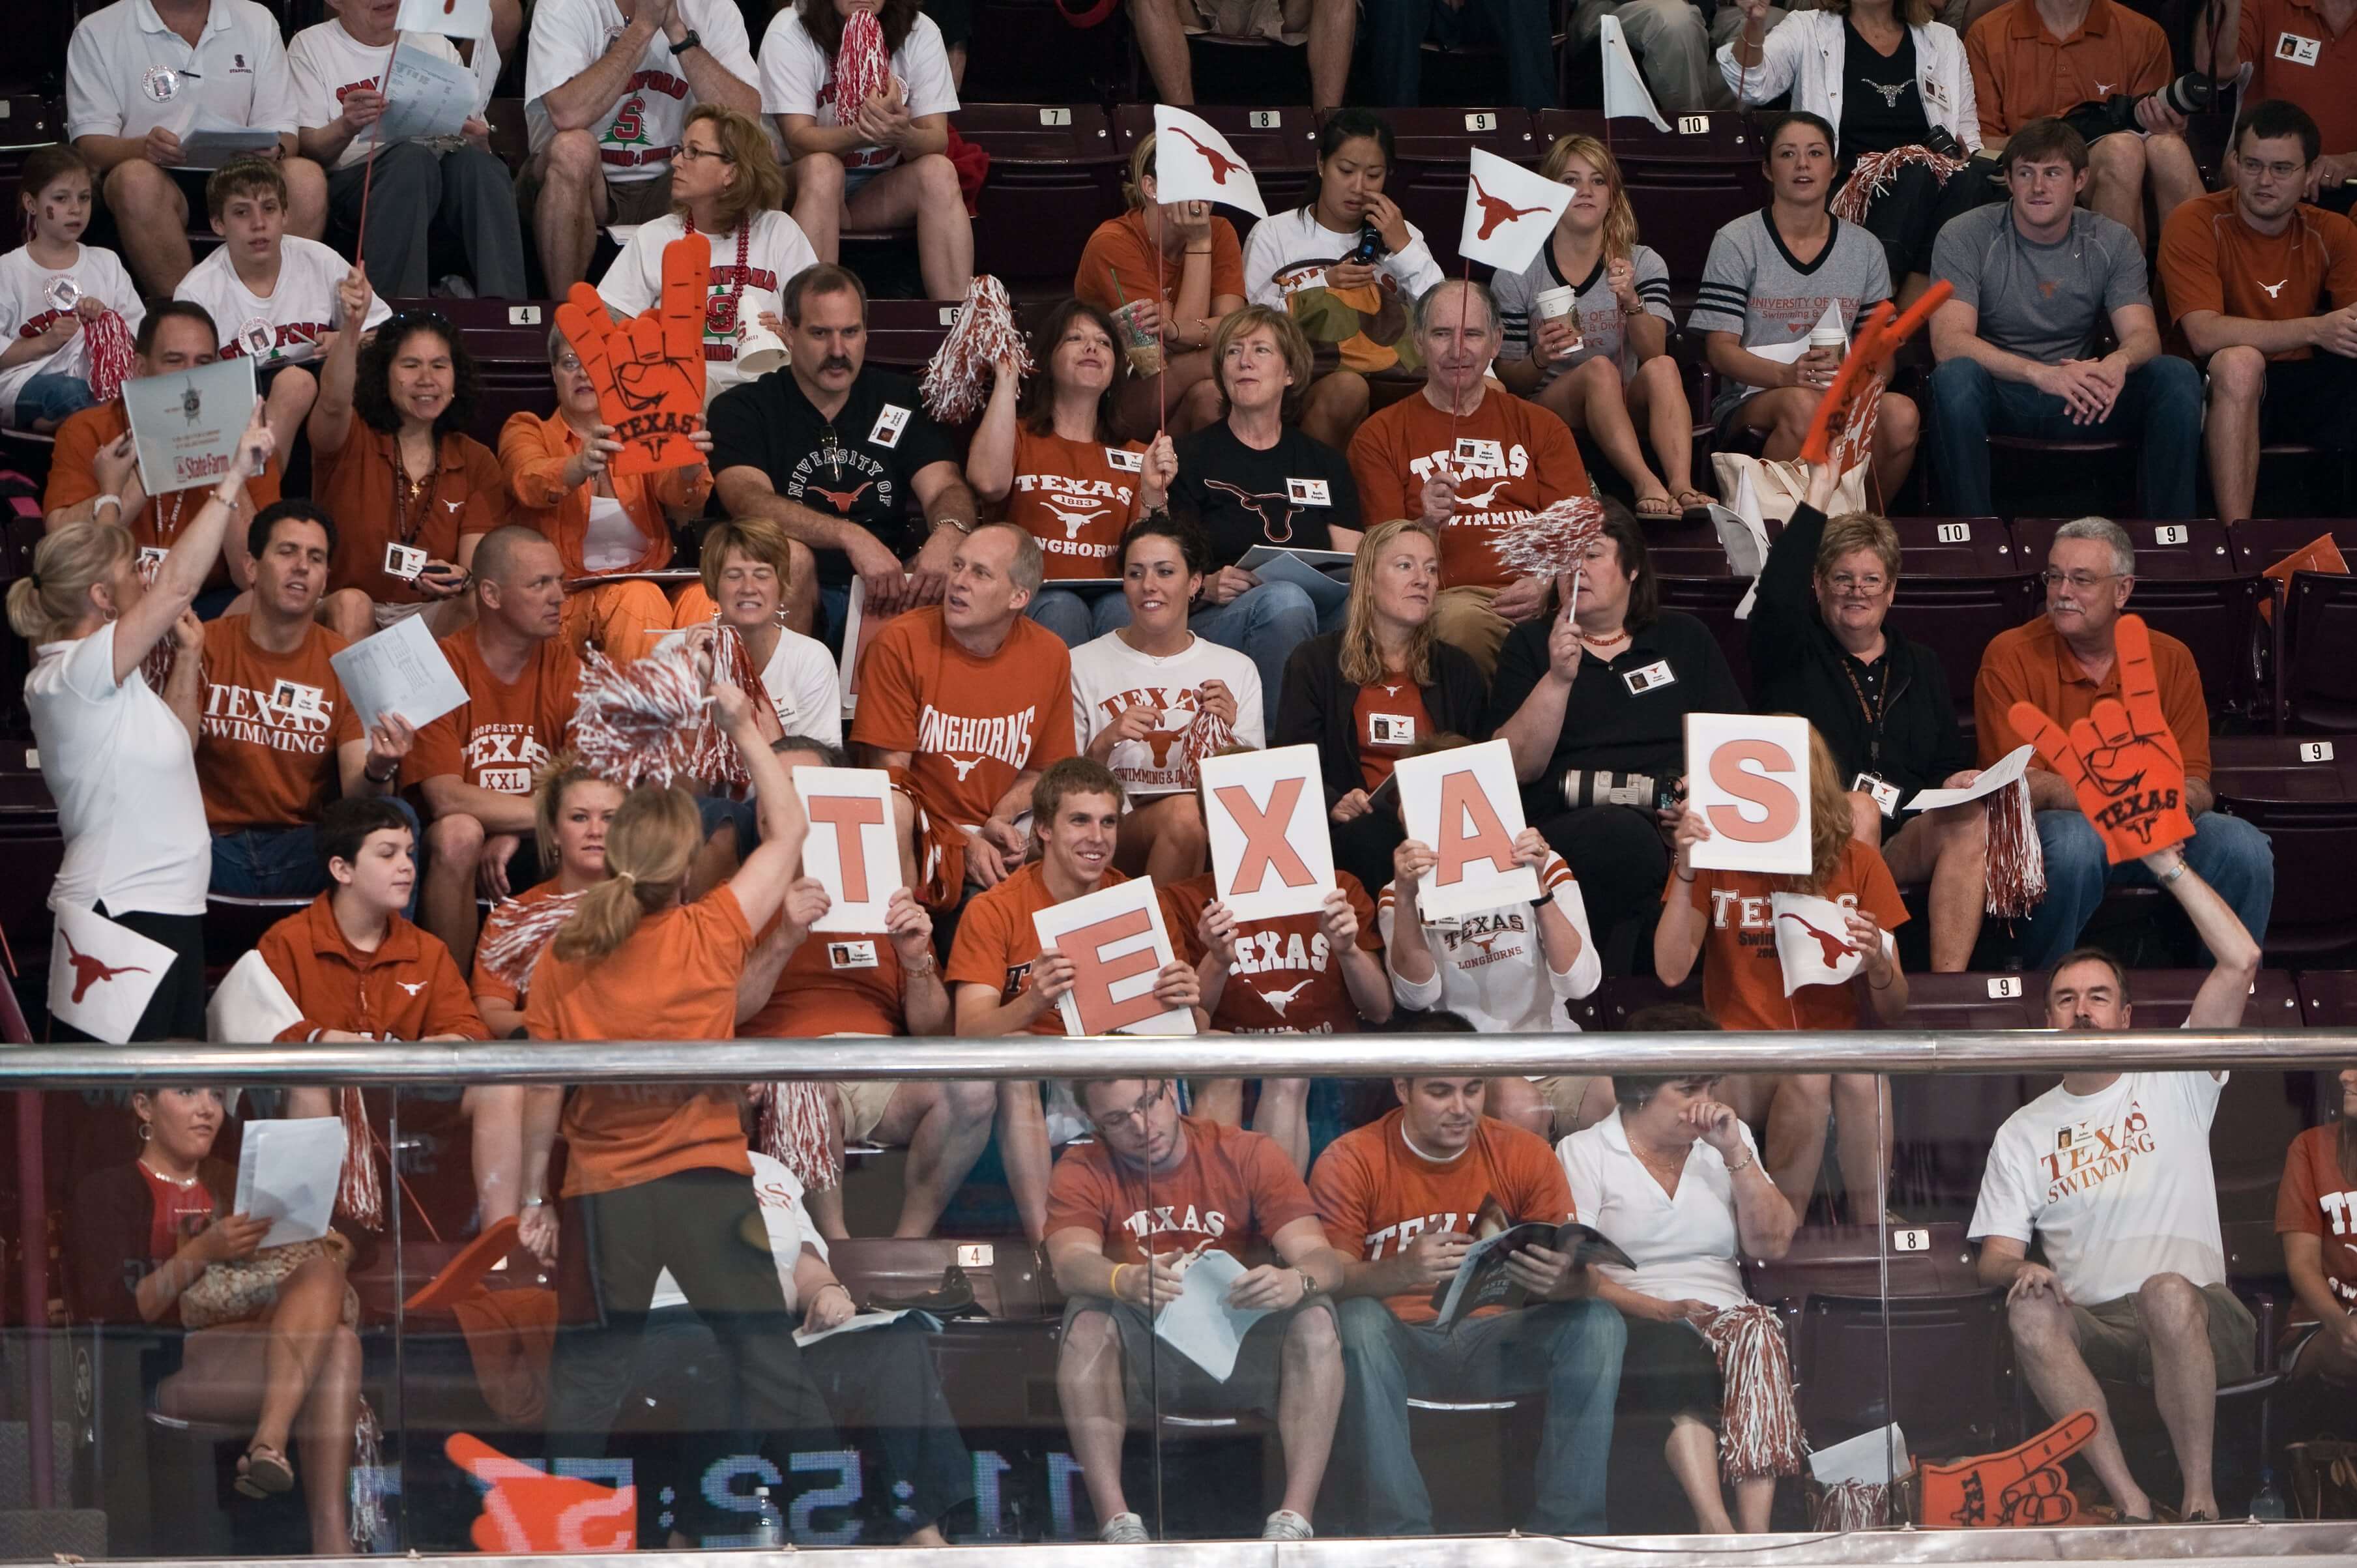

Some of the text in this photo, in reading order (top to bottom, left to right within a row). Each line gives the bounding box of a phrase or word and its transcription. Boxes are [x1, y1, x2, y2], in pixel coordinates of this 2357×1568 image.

[613, 97, 646, 140] S
[1050, 111, 1059, 125] 7
[1261, 113, 1269, 127] 8
[1476, 115, 1485, 129] 9
[1685, 117, 1701, 133] 10
[1748, 297, 1810, 310] UNIVERSITY
[521, 308, 529, 323] 4
[950, 308, 959, 324] 6
[1761, 310, 1809, 320] Swimming
[1812, 310, 1820, 319] &
[615, 412, 697, 443] TEXAS
[788, 448, 892, 506] NIVERSITY OF
[1015, 474, 1134, 506] TEXAS
[1060, 495, 1093, 506] 1883
[1943, 525, 1963, 541] 10
[2167, 527, 2176, 542] 9
[1098, 687, 1196, 721] TEXA
[198, 717, 325, 755] SWIMMING
[528, 725, 535, 735] O
[2313, 744, 2322, 759] 9
[485, 773, 524, 790] XXL
[1114, 768, 1165, 785] SWIMMING
[1166, 770, 1174, 785] &
[1705, 739, 1800, 843] S
[2094, 788, 2178, 831] TEXAS
[1213, 777, 1318, 895] X
[1436, 769, 1526, 887] A
[807, 795, 885, 903] T
[1444, 914, 1527, 952] TEXAS
[1458, 946, 1524, 970] LONGHORNS
[1056, 907, 1179, 1035] E
[2000, 980, 2010, 996] 9
[1122, 1204, 1225, 1242] TEXAS
[1907, 1231, 1916, 1249] 8
[970, 1246, 981, 1265] 4
